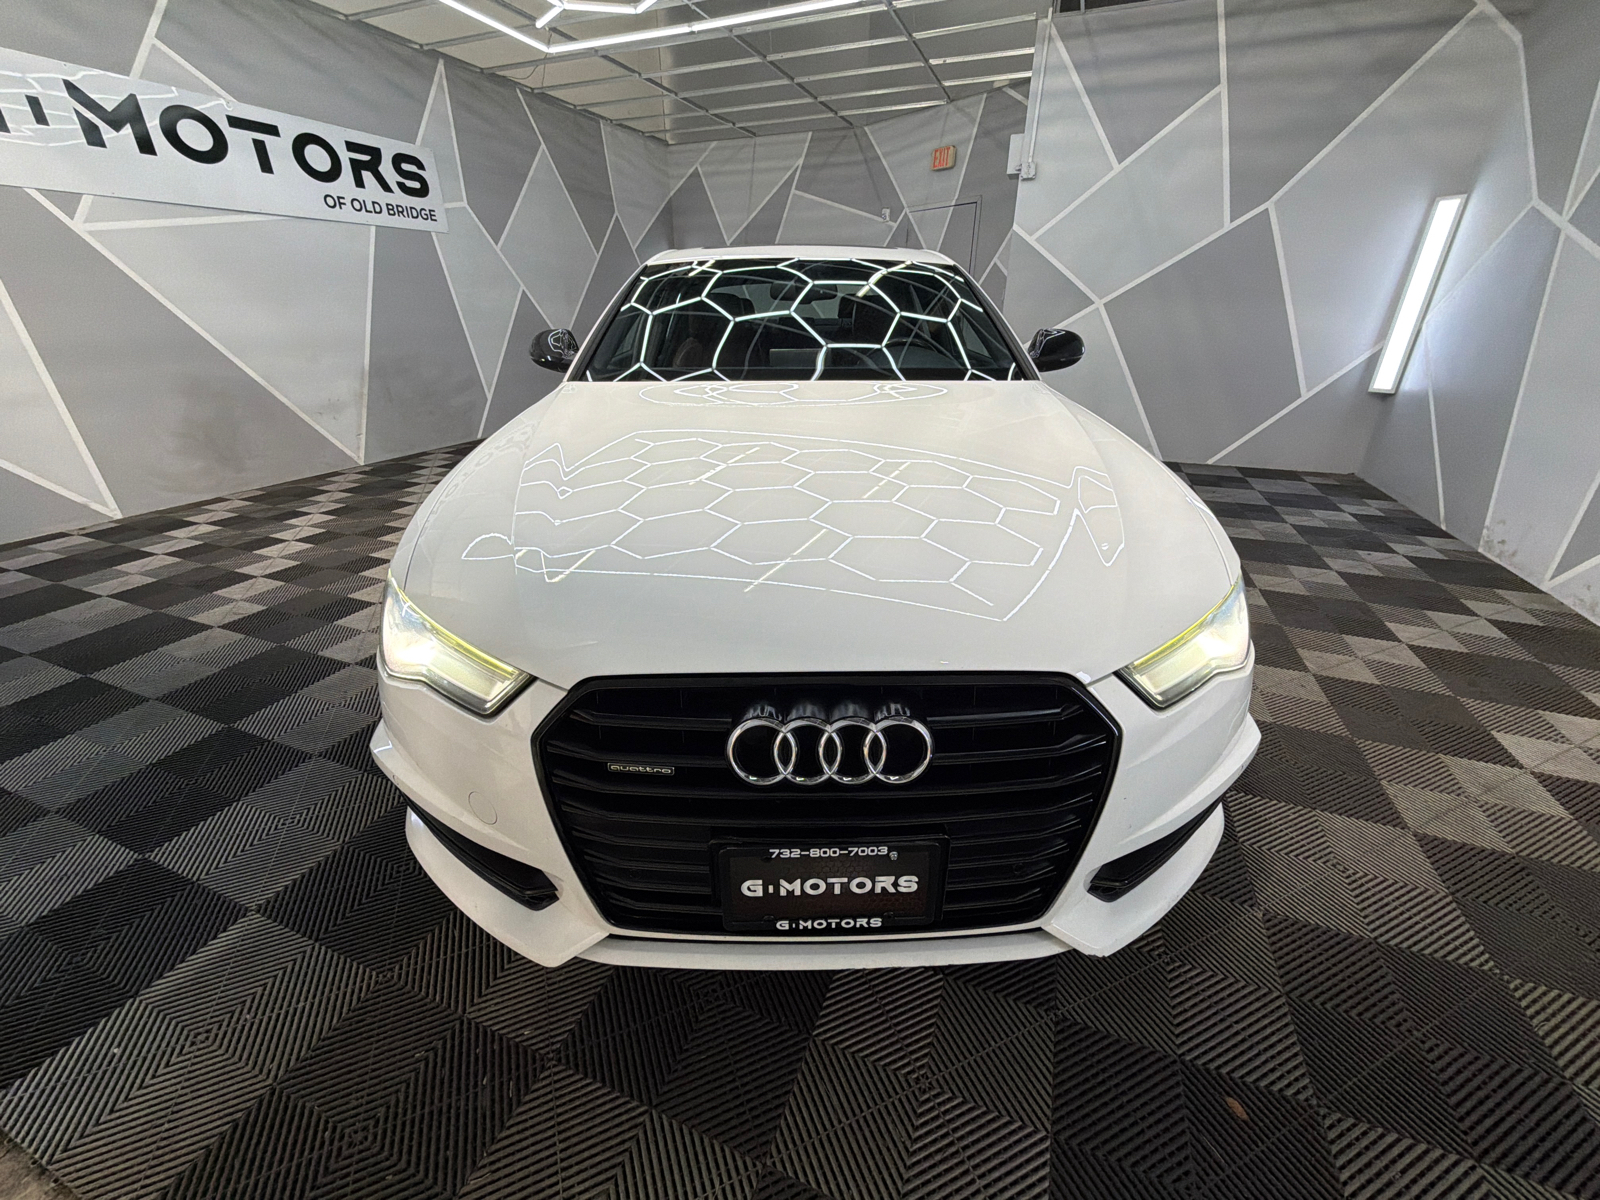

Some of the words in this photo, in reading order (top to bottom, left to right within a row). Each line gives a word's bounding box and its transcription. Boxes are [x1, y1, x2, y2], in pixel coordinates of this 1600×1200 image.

[932, 146, 951, 169] EXIT
[323, 194, 347, 210] OF
[350, 198, 383, 215] OLD
[385, 203, 438, 222] BRIDGE
[610, 765, 672, 774] quattro
[769, 846, 888, 859] 732-800-7003
